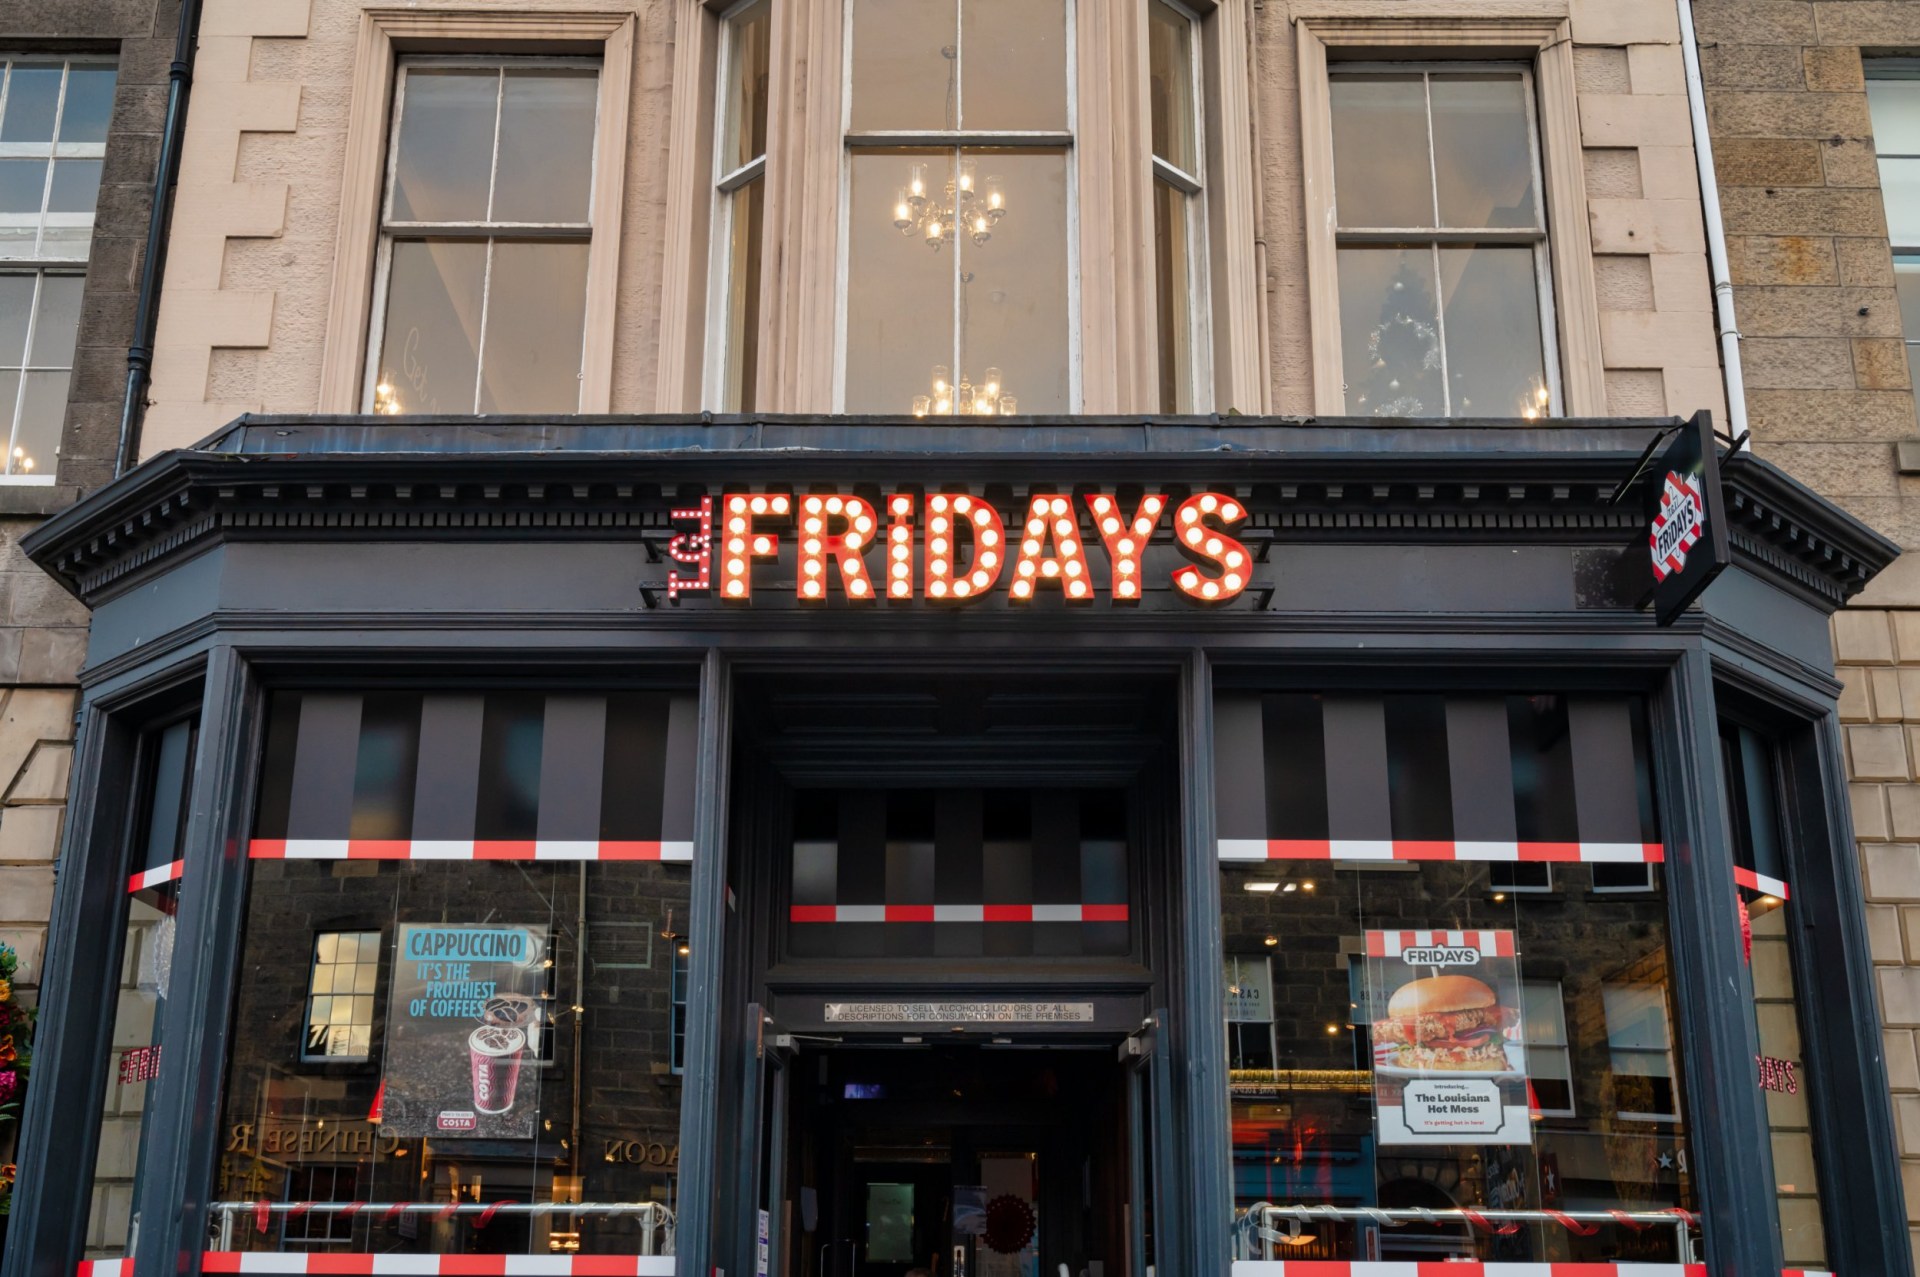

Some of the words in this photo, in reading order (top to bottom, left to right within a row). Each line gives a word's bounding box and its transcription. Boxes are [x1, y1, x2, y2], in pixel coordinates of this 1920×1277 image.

[411, 932, 521, 957] CAPPUCCINO
[1407, 950, 1475, 963] FRIDAYS
[416, 963, 442, 980] IT'S
[446, 963, 471, 980] THE
[426, 981, 496, 999] FROTHIEST
[410, 999, 427, 1017] OF
[430, 1000, 485, 1017] COFFEES
[479, 1064, 491, 1101] COSTA
[1415, 1094, 1436, 1102] The
[1438, 1093, 1490, 1102] Louisiana
[1428, 1105, 1448, 1113] Hot
[1450, 1105, 1479, 1113] Mess
[442, 1119, 471, 1127] COSTA
